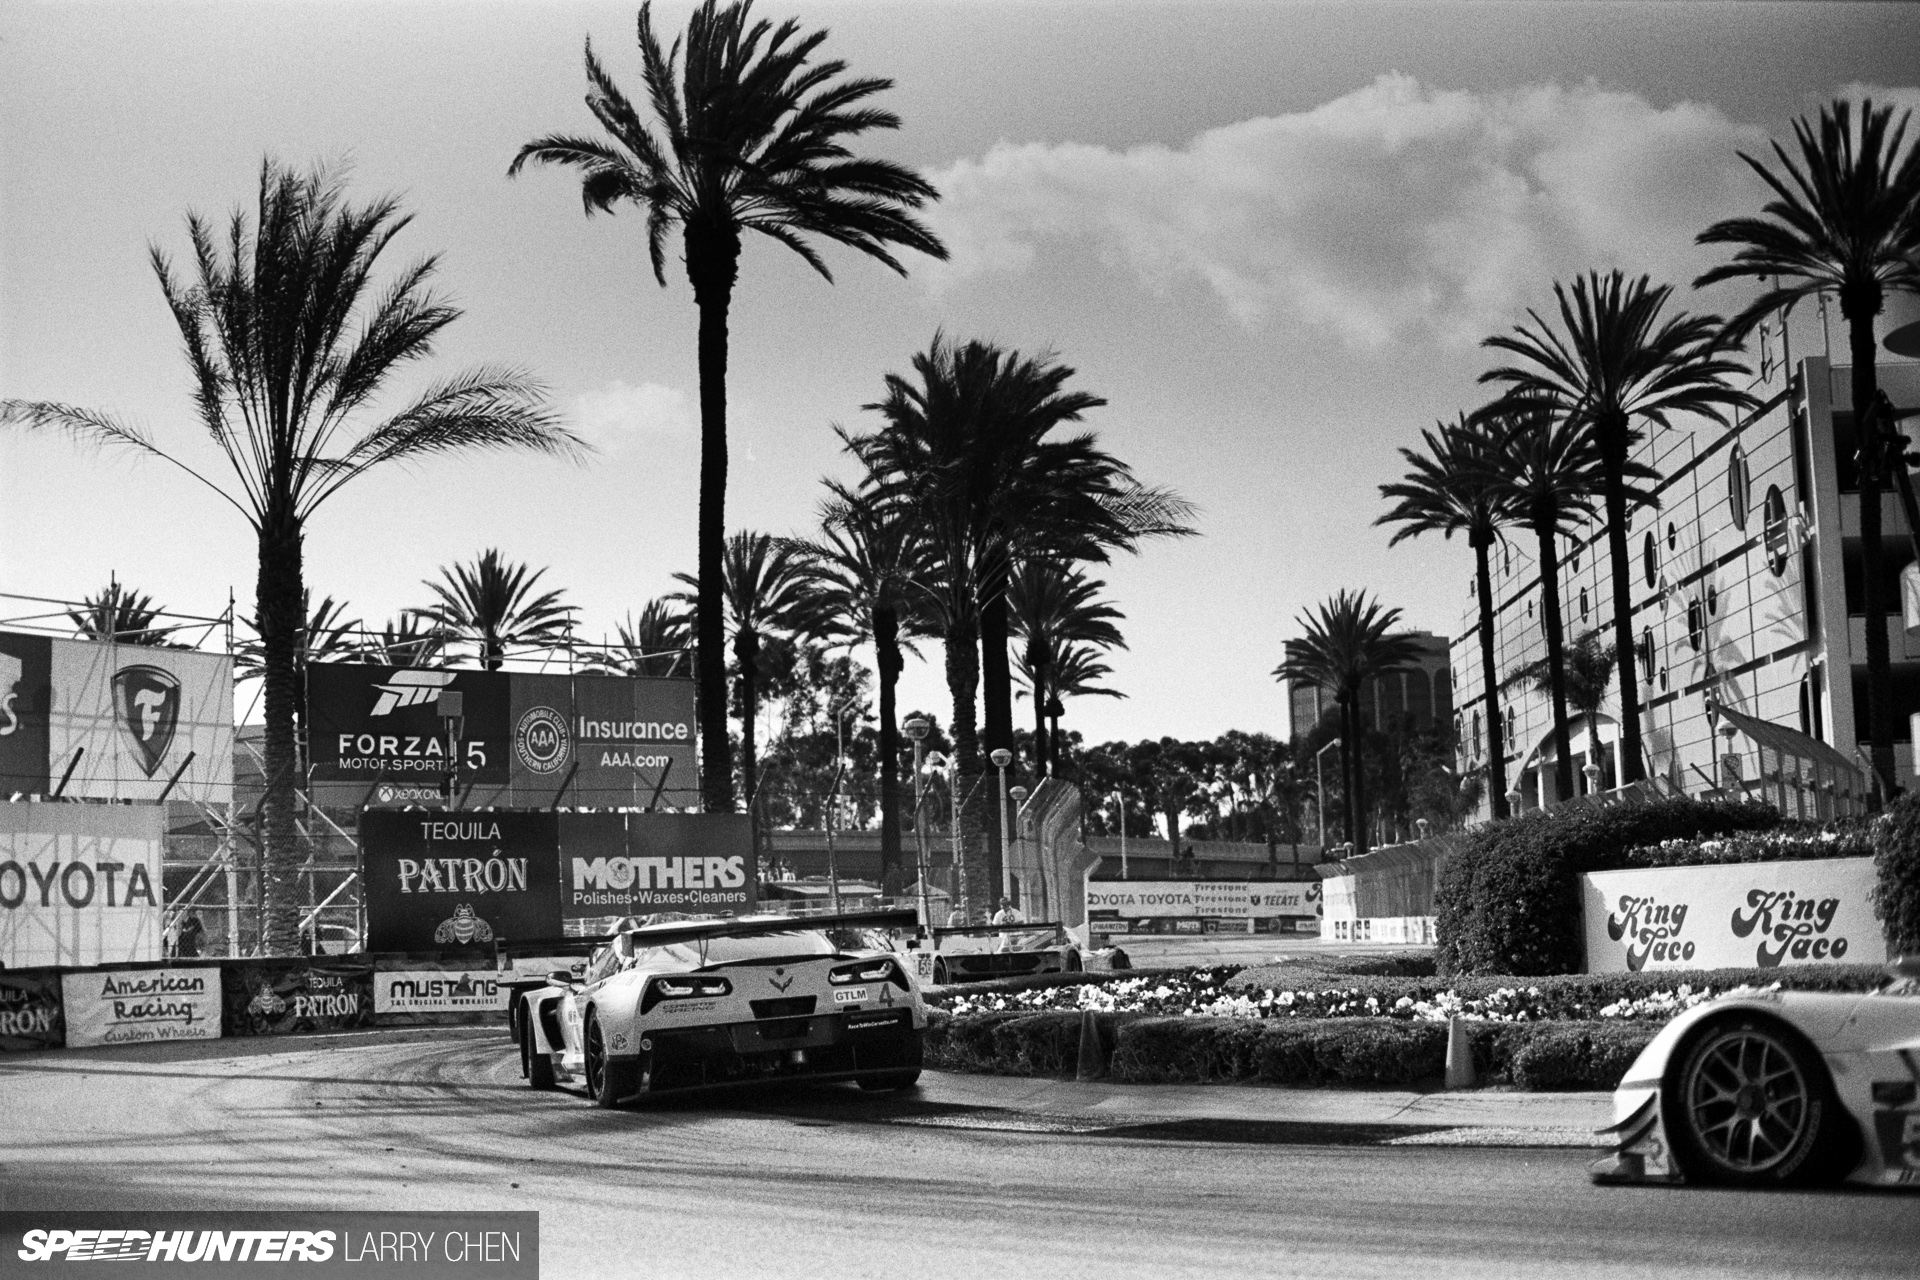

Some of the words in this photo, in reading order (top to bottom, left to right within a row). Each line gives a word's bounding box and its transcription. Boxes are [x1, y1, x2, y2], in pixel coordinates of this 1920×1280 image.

[552, 715, 566, 735] CLUB
[579, 716, 688, 740] Insurance
[530, 730, 555, 747] AAA
[339, 734, 443, 756] FORZA
[467, 741, 486, 770] 5
[601, 752, 669, 767] AAA.com
[421, 821, 501, 840] TEQUILA
[398, 849, 528, 893] PATRÓN
[572, 856, 746, 890] MOTHERS
[0, 861, 157, 909] OYOTA
[1195, 884, 1247, 893] Firestone
[1089, 894, 1135, 905] OYOTA
[1139, 894, 1192, 905] TOYOTA
[1195, 895, 1247, 904] Firestone
[1195, 906, 1247, 915] Firestone
[1264, 895, 1299, 906] TECATE
[1608, 895, 1688, 941] King
[1731, 889, 1840, 938] King
[1626, 928, 1695, 972] Taco
[1757, 923, 1848, 968] Taco
[101, 973, 204, 996] American
[835, 990, 867, 1001] GTLM
[879, 983, 895, 1008] 4
[114, 998, 193, 1025] Racing
[295, 988, 359, 1017] PATRÓN
[104, 1029, 154, 1042] Custom
